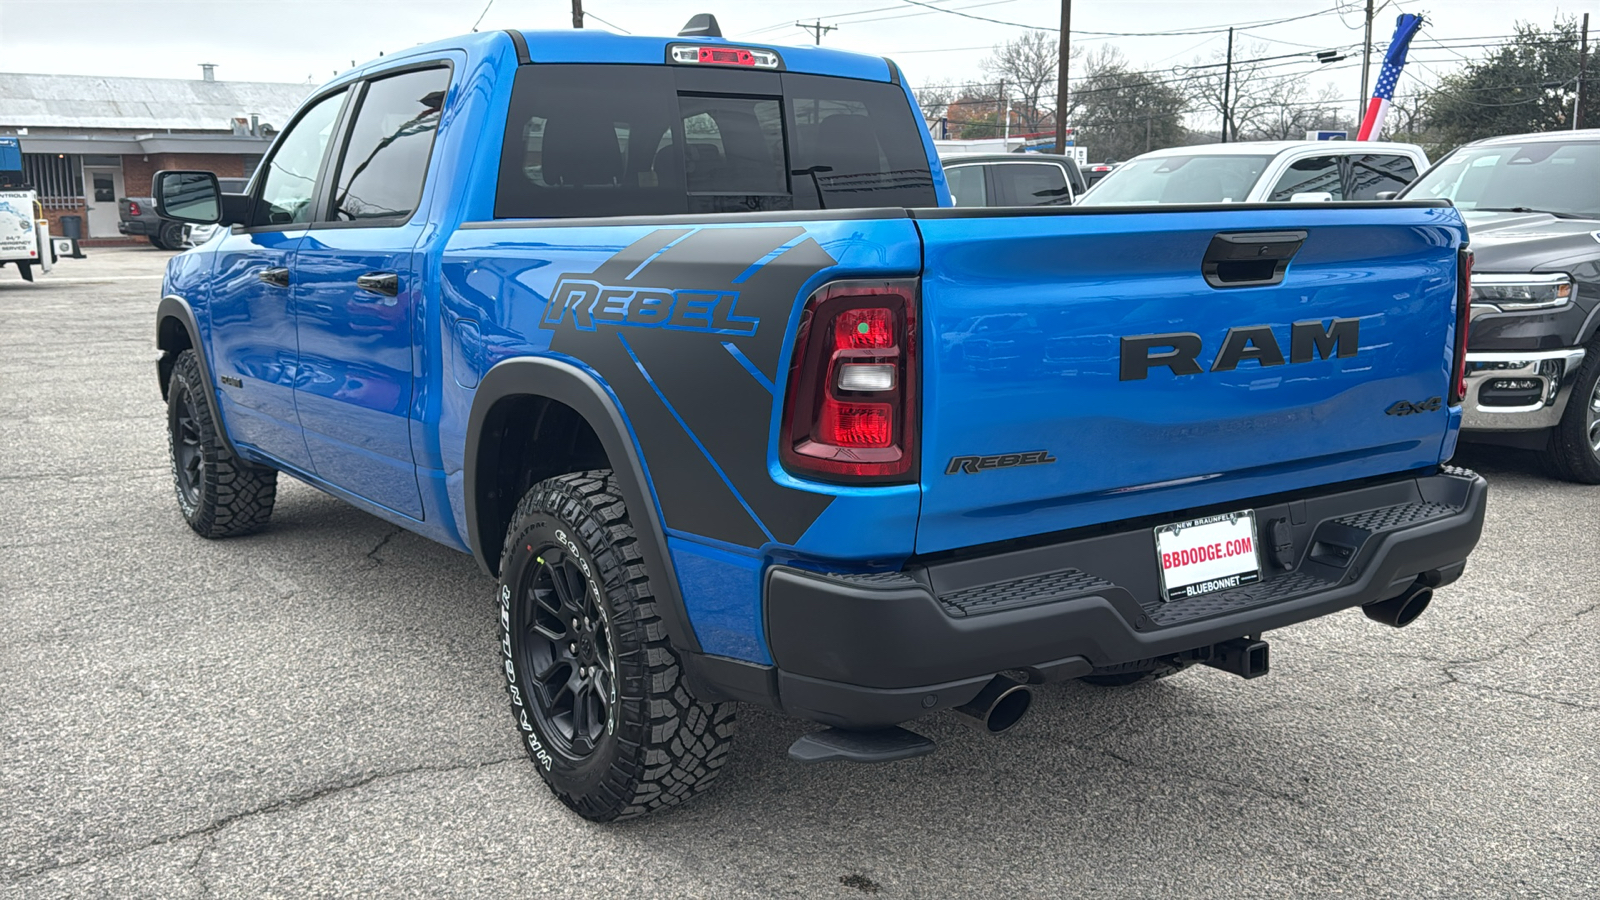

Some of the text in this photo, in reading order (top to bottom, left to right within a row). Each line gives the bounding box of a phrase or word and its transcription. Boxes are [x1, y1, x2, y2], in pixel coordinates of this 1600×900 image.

[544, 279, 760, 336] REBEL
[1119, 318, 1360, 381] RAM
[945, 449, 1056, 475] REBEL
[1176, 513, 1235, 529] NEW BRAUNFELS
[1162, 537, 1252, 570] BBDODGE.COM
[1186, 575, 1240, 596] BLUEBONNET
[502, 585, 553, 771] WRANGLER
